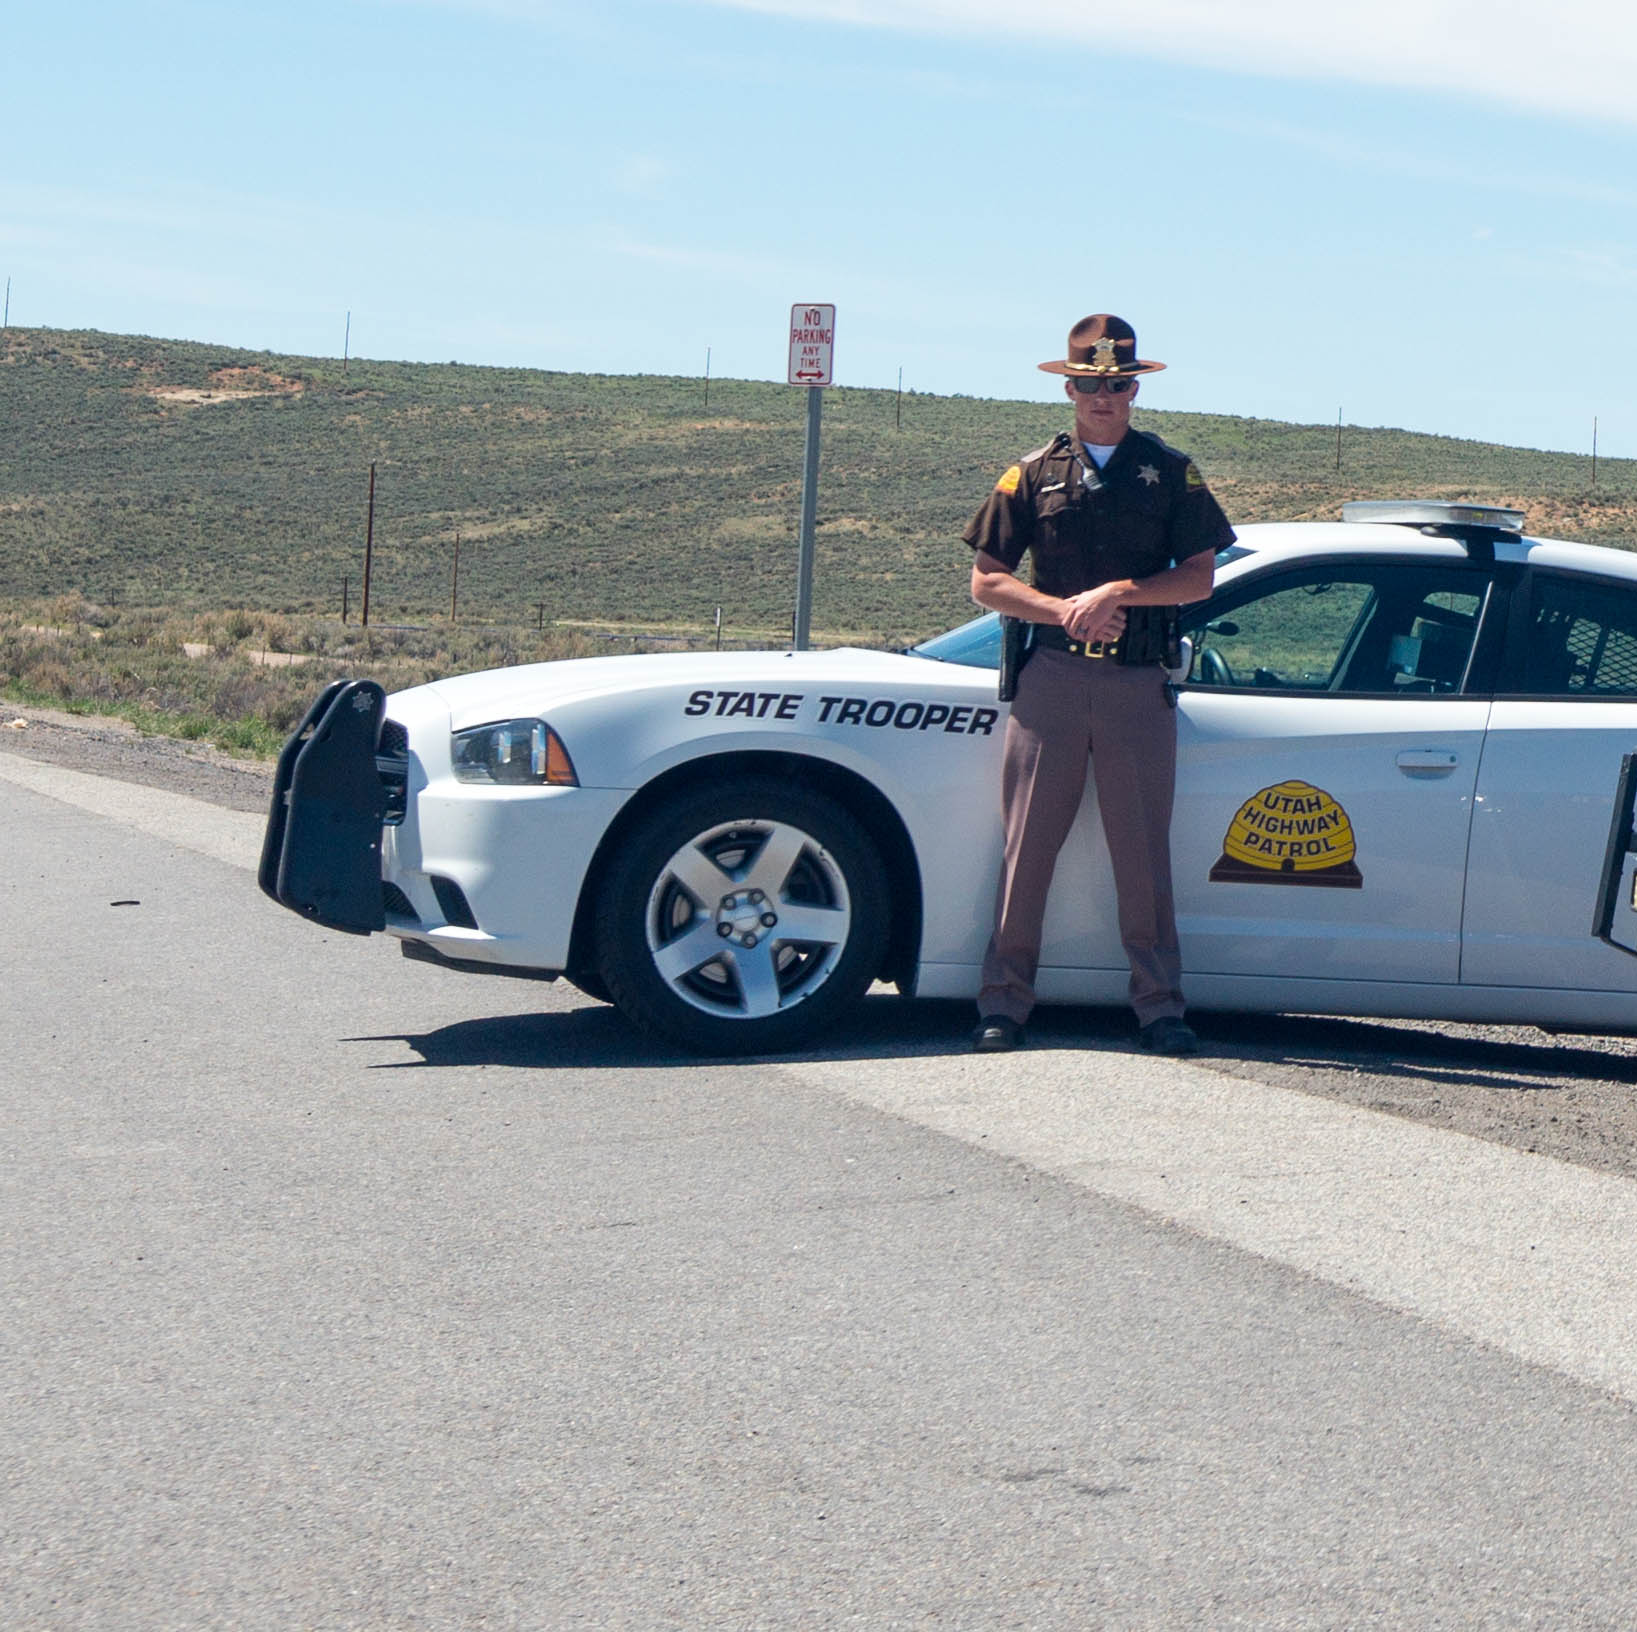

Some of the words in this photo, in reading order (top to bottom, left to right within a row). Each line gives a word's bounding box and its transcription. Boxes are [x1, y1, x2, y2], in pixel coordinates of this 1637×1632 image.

[804, 310, 821, 326] NO
[792, 329, 831, 344] PARKING
[802, 346, 820, 356] ANY
[801, 357, 821, 368] TIME
[684, 689, 804, 720] STATE
[816, 696, 1000, 736] TROOPER
[1263, 792, 1322, 814] UTAH
[1243, 806, 1340, 835] HIGHWAY
[1243, 831, 1337, 857] PATROL
